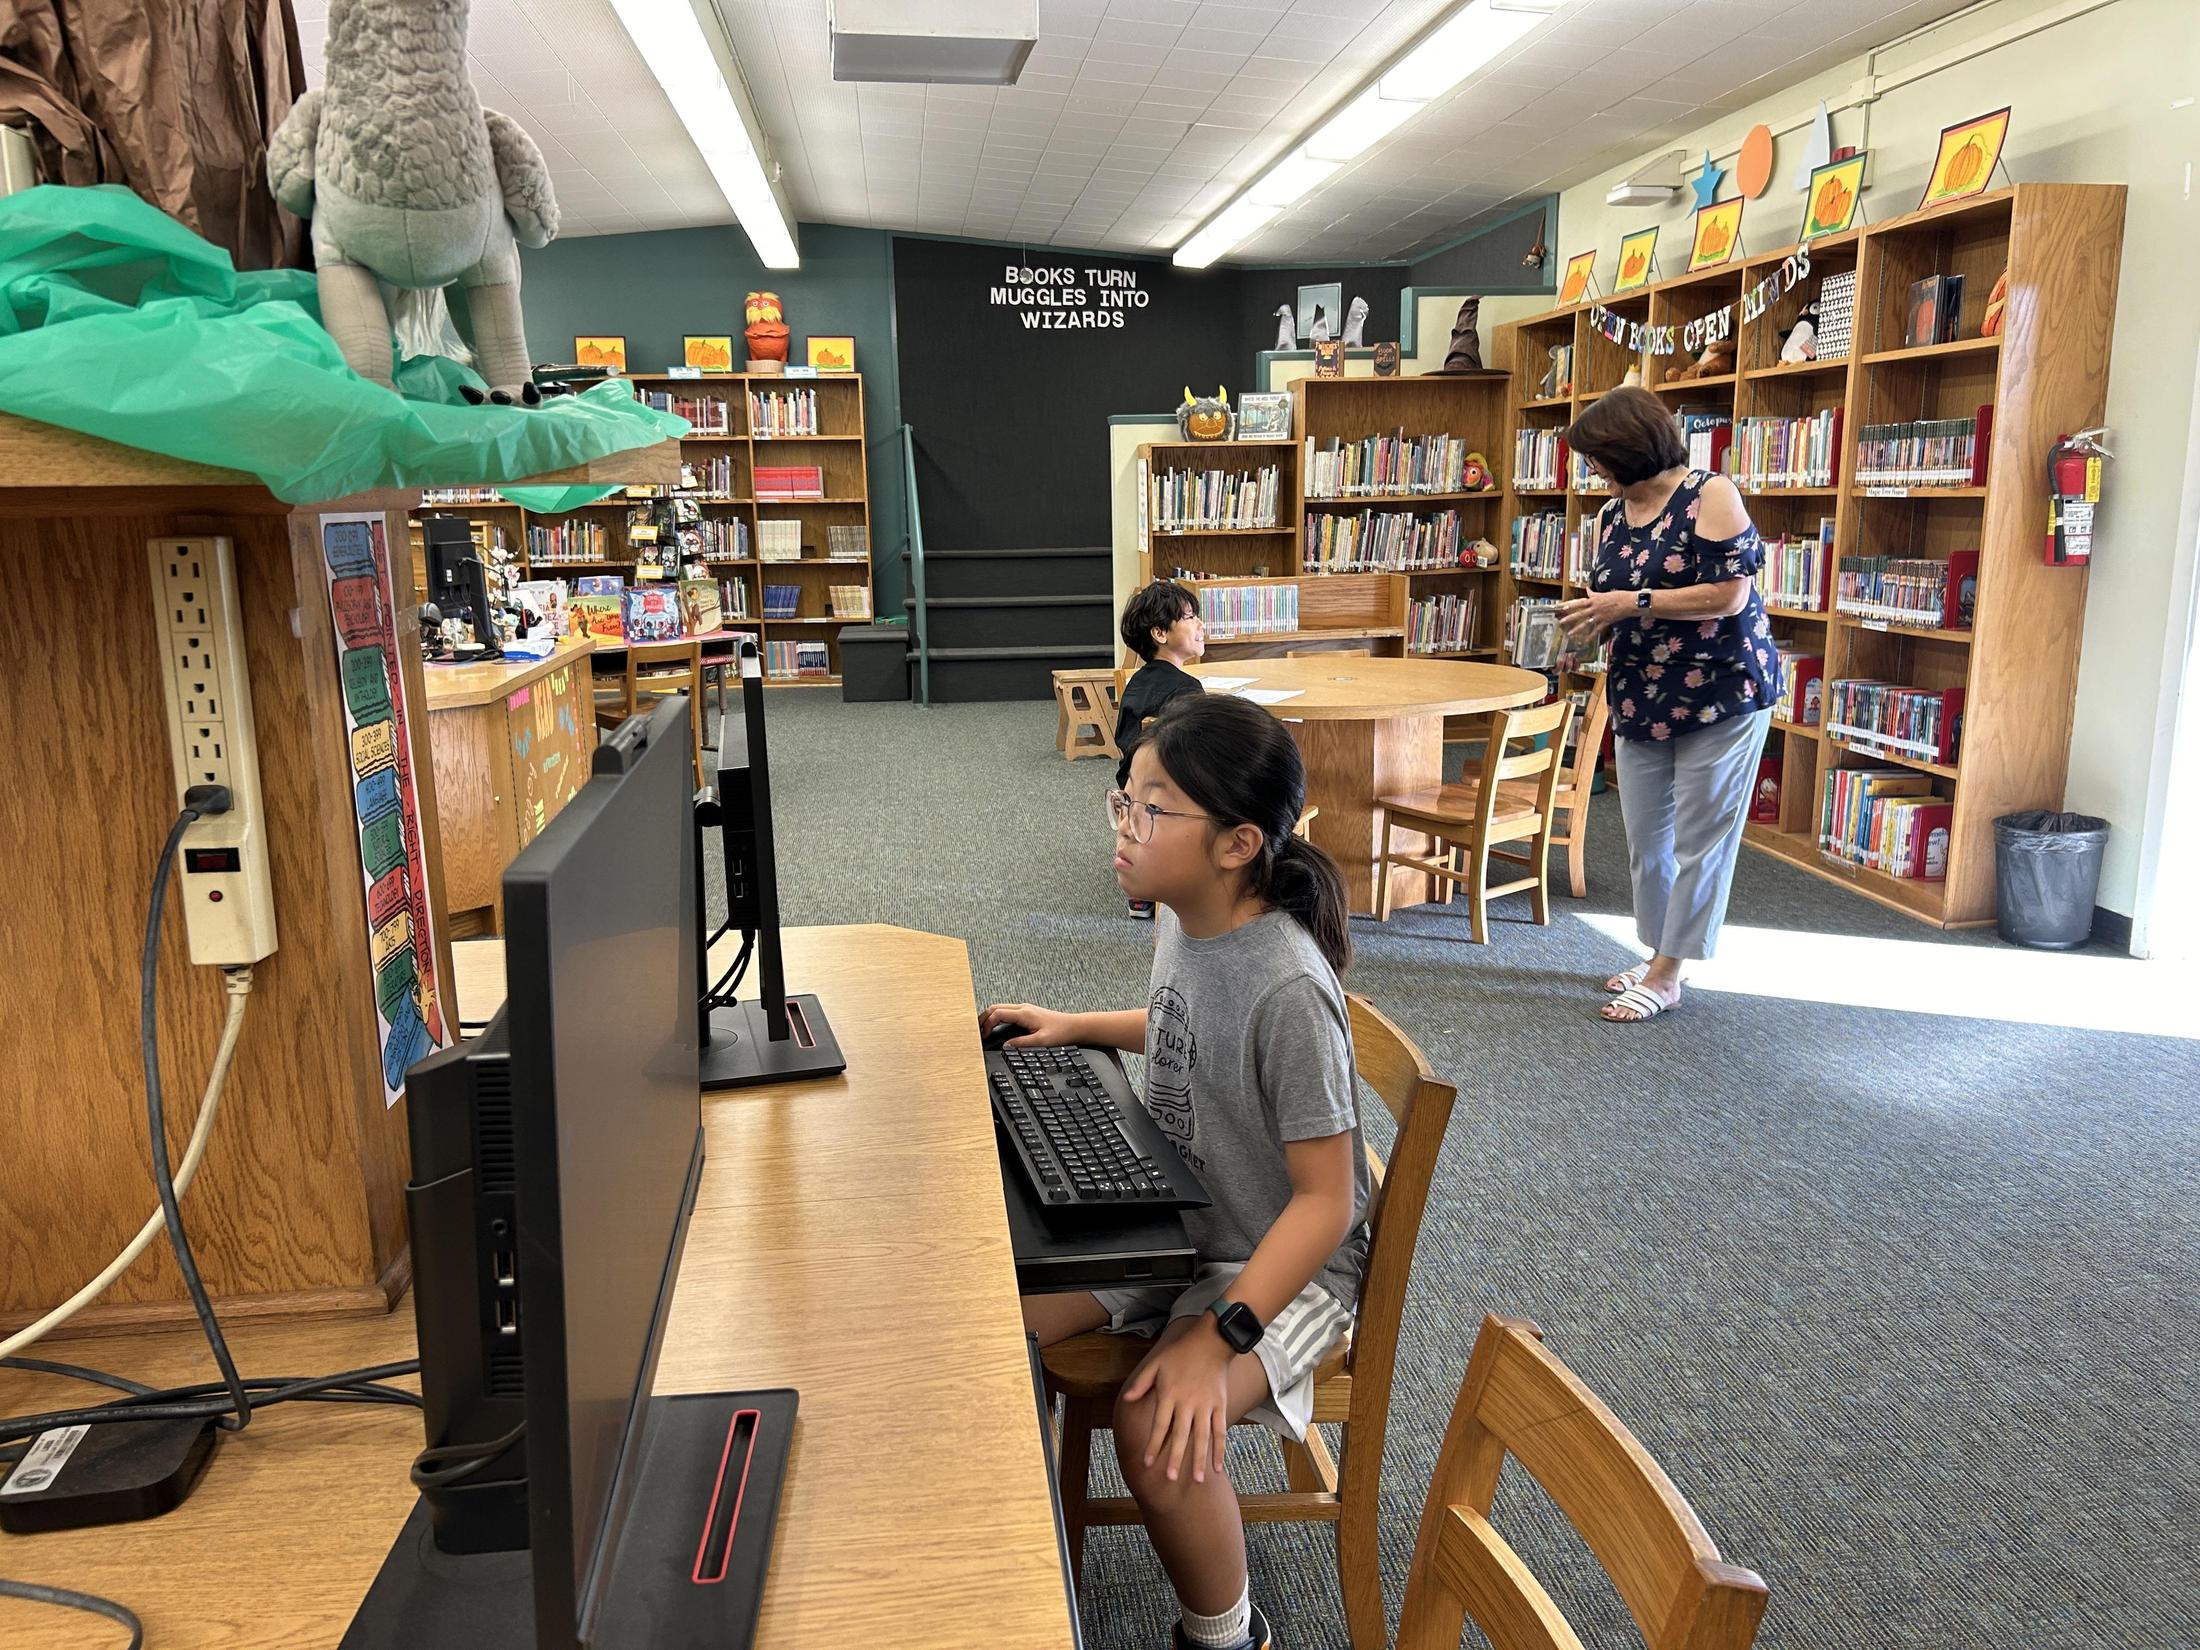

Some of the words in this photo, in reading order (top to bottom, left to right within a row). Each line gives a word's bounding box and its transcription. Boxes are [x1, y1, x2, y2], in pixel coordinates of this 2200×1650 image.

[1005, 266, 1075, 285] BOOKS
[1085, 269, 1136, 288] TURN
[990, 288, 1087, 306] MUGGLES
[1100, 290, 1149, 307] INTO
[1590, 301, 1627, 346] OPEN
[1628, 320, 1675, 355] BOOKS
[1683, 305, 1732, 352] OPEN
[1743, 243, 1811, 325] MINDS
[1020, 311, 1125, 329] WIZARDS
[587, 605, 612, 616] Where
[534, 678, 554, 742] READ
[383, 603, 398, 685] POINTED
[400, 752, 410, 788] THE
[406, 812, 420, 865] RIGHT
[413, 889, 431, 974] DIRECTION
[1152, 1048, 1184, 1074] lorer
